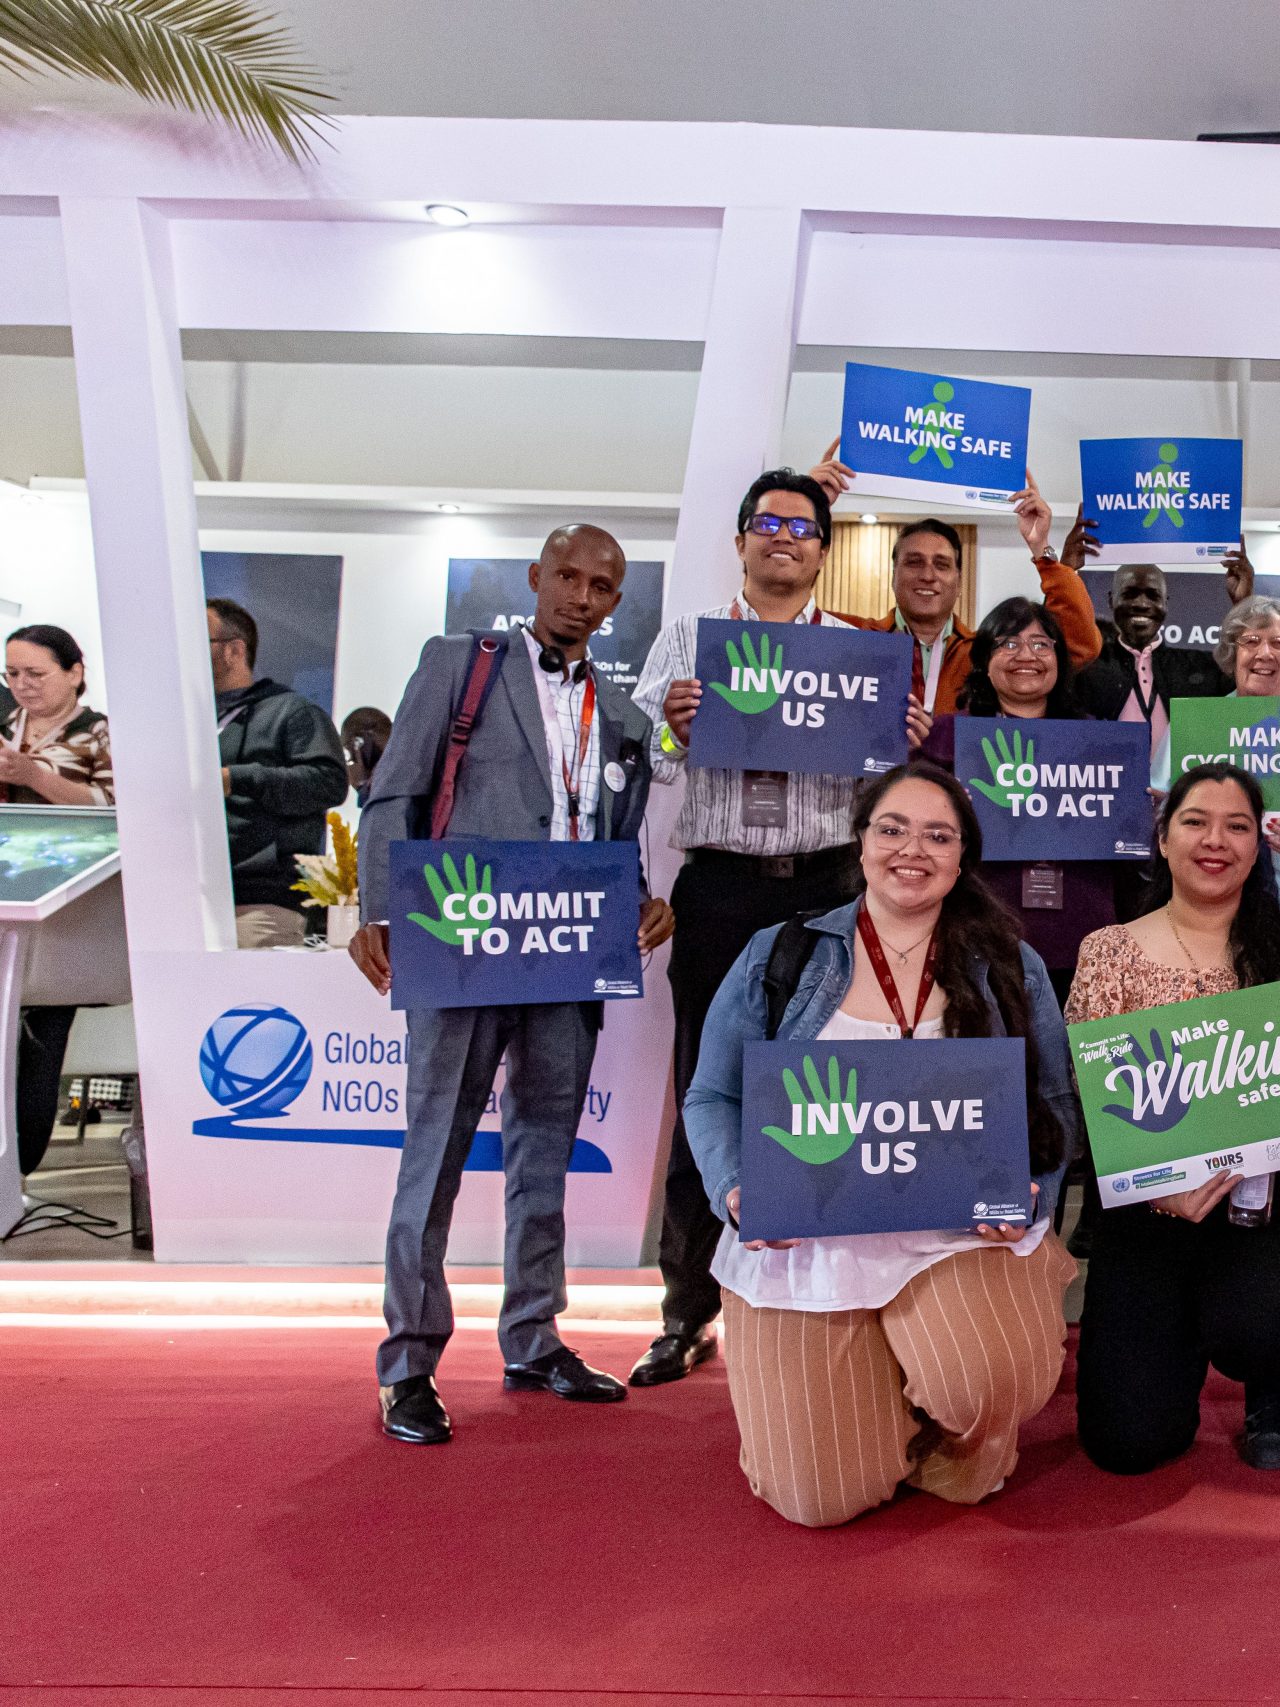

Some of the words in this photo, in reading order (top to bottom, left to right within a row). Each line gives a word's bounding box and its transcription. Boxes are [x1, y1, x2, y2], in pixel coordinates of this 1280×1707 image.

[904, 406, 965, 431] MAKE
[858, 421, 957, 451] WALKING
[961, 436, 1012, 459] SAFE
[1135, 471, 1191, 488] MAKE
[1097, 493, 1186, 511] WALKING
[1189, 492, 1231, 510] SAFE
[1187, 625, 1223, 644] AC
[730, 666, 879, 702] INVOLVE
[782, 701, 826, 728] US
[996, 763, 1123, 788] COMMIT
[1007, 793, 1048, 817] TO
[1056, 793, 1114, 817] ACT
[442, 891, 605, 921] COMMIT
[456, 927, 510, 955] TO
[520, 925, 594, 954] ACT
[1171, 1019, 1229, 1046] Make
[324, 1031, 410, 1065] Global
[1079, 1044, 1108, 1064] Walk
[322, 1080, 399, 1112] NGOs
[791, 1099, 984, 1136] INVOLVE
[861, 1141, 917, 1175] US
[1204, 1152, 1244, 1170] YOURS
